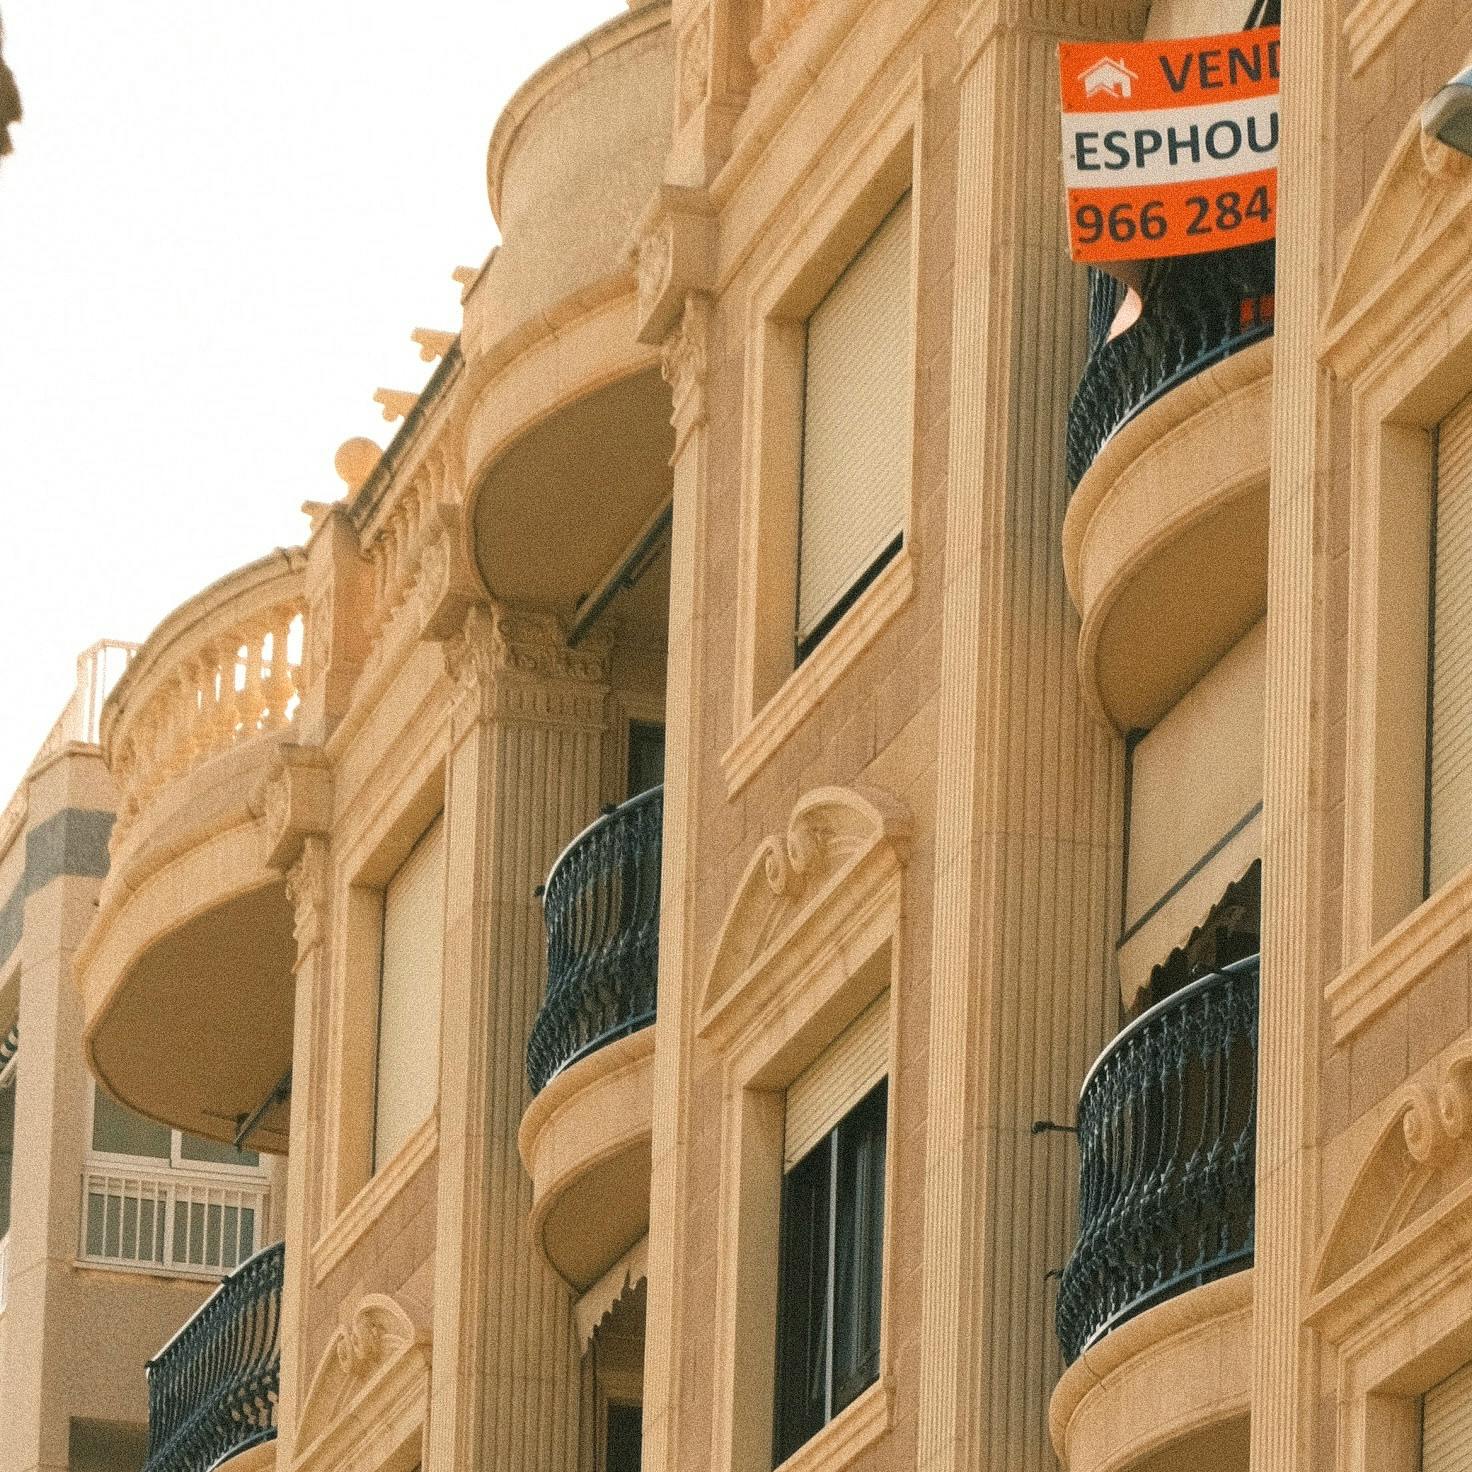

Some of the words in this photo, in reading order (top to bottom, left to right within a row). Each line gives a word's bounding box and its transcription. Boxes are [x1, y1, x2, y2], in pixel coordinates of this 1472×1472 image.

[1074, 112, 1279, 171] ESPHOU
[1075, 200, 1167, 244] 966
[1184, 185, 1272, 236] 284
